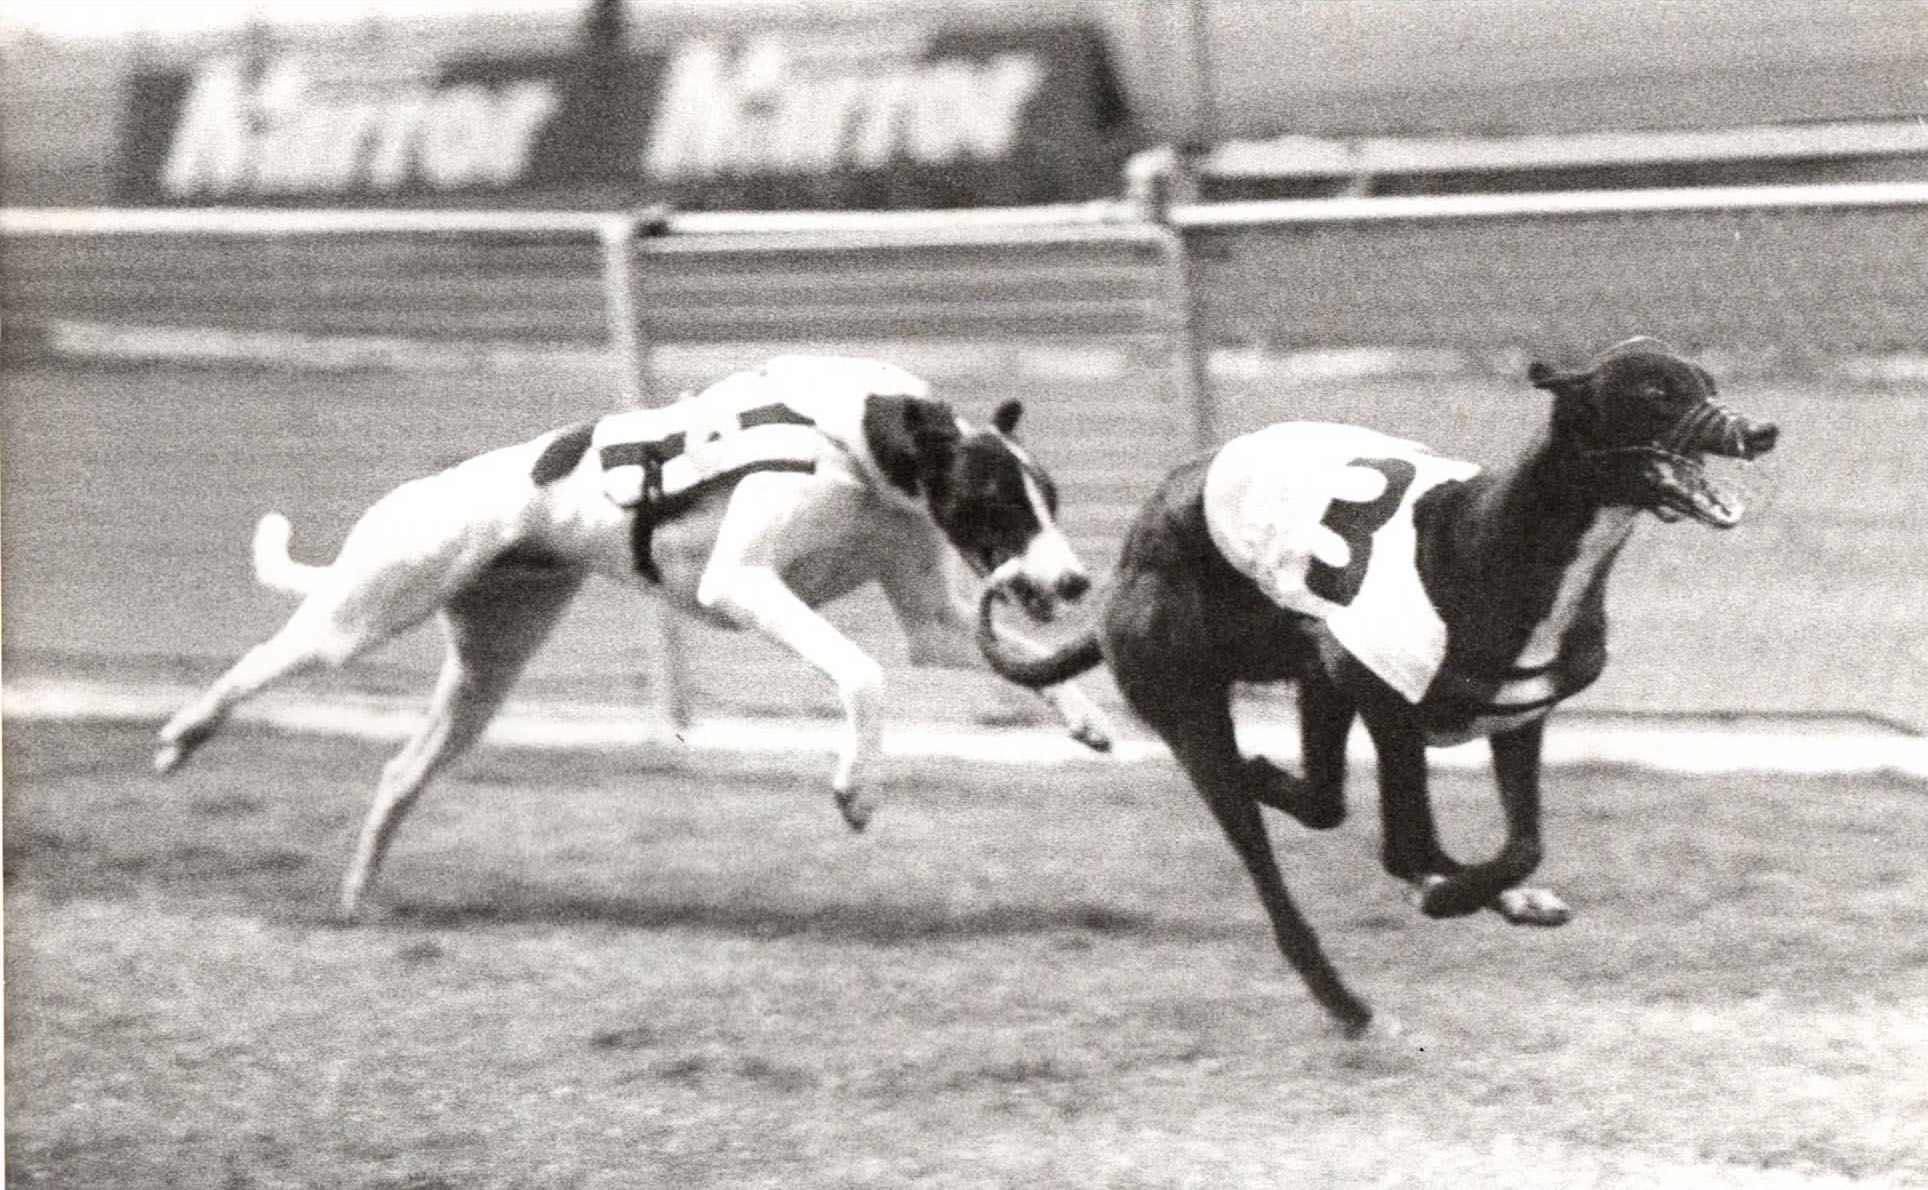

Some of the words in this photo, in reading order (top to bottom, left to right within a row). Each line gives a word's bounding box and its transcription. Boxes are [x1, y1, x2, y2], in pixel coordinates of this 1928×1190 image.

[162, 56, 558, 195] Mirror
[642, 38, 1044, 179] Mirror
[1304, 457, 1416, 607] 3
